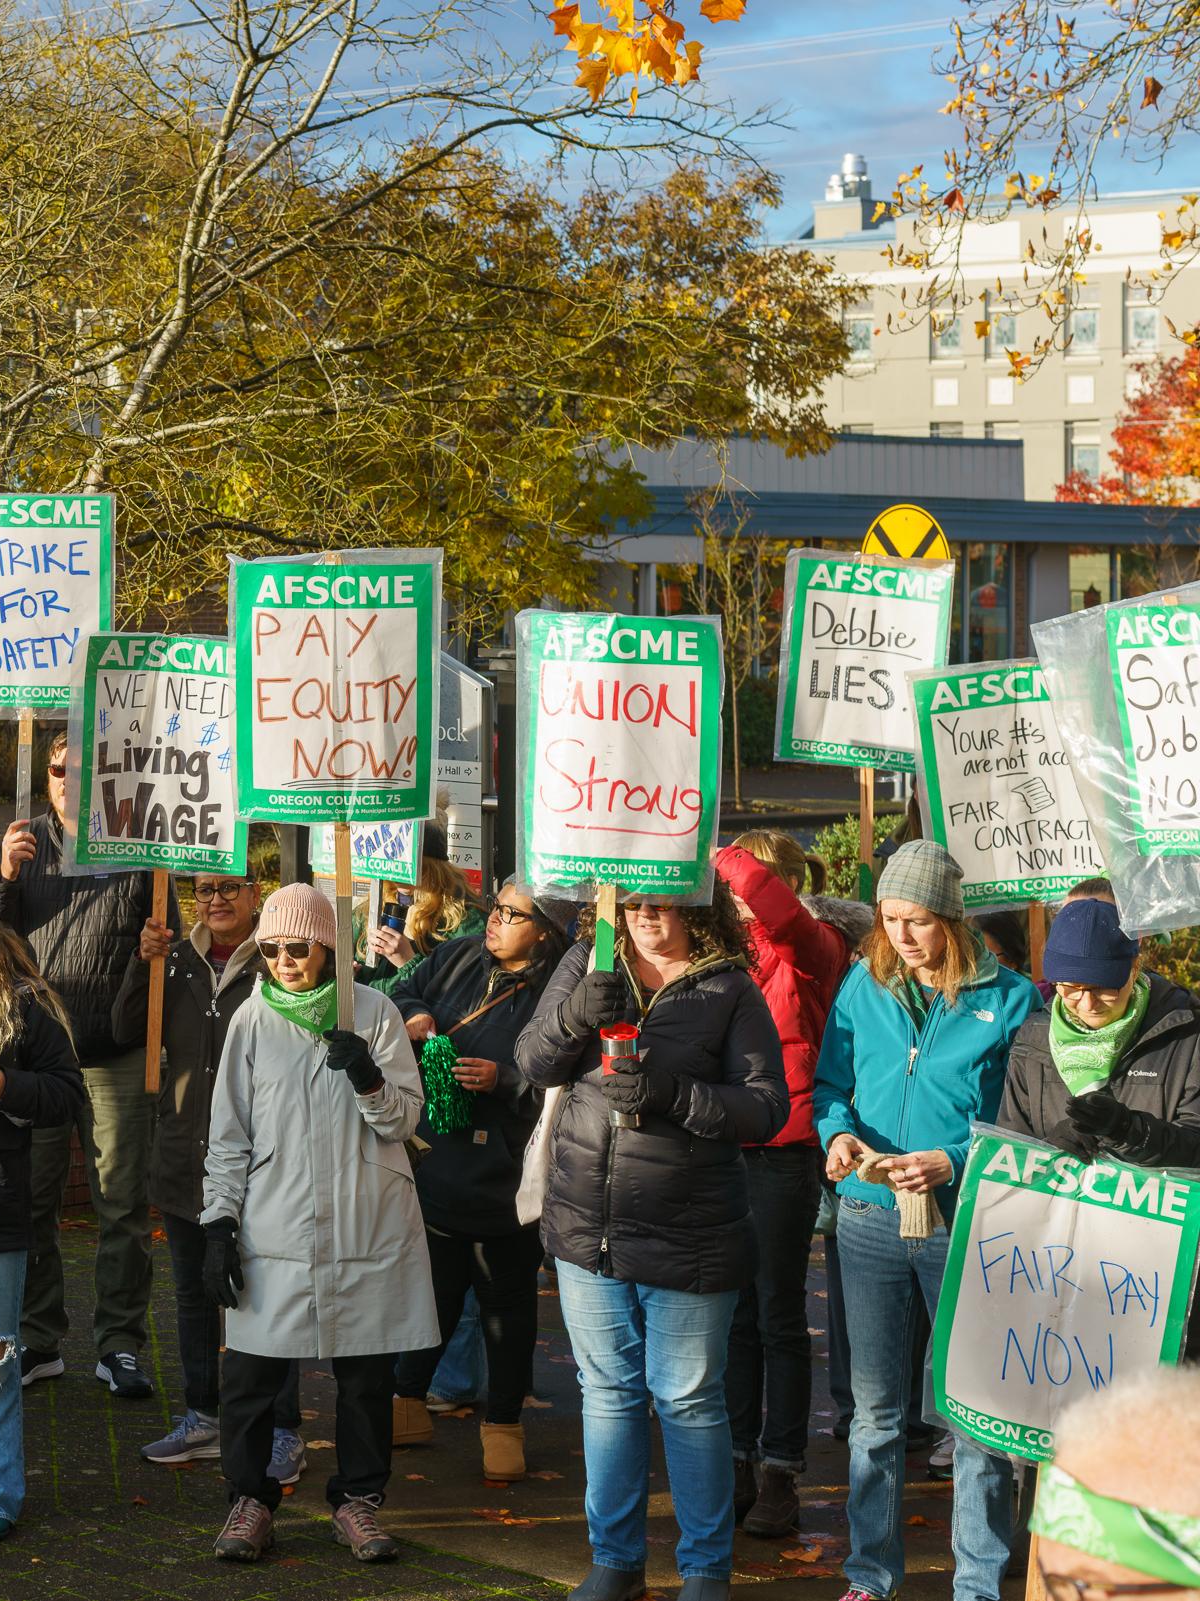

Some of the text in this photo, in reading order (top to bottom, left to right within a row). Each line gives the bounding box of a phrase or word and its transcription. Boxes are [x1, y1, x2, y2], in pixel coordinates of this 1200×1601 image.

[256, 576, 414, 604] AFSCME
[808, 564, 945, 600] AFSCME
[0, 588, 70, 623] FOR
[256, 613, 378, 657] PAY
[812, 601, 916, 648] Debbie
[543, 627, 698, 661] AFSCME
[104, 674, 236, 719] WE NEED
[257, 675, 416, 723] EQUITY
[541, 664, 696, 737] UNION
[809, 659, 908, 712] LIES.
[129, 720, 141, 735] a
[937, 717, 1003, 755] YOUR
[1136, 714, 1197, 762] Job
[98, 736, 211, 803] Living
[445, 766, 461, 775] Hall
[791, 741, 847, 756] OREGON
[850, 747, 907, 764] COUNCIL
[963, 757, 996, 777] are
[996, 749, 1028, 773] not
[102, 779, 221, 846] WAGE
[269, 795, 400, 806] OREGON COUNCIL 75
[949, 800, 1004, 827] FAIR
[88, 843, 147, 857] OREGON
[151, 846, 212, 862] COUNCIL
[217, 853, 234, 864] 75
[975, 820, 1092, 851] CONTRACT
[1146, 830, 1199, 842] OREGON
[599, 863, 660, 876] COUNCIL
[665, 866, 680, 877] 75
[1017, 848, 1063, 873] NOW
[982, 1143, 1190, 1221] AFSCME
[979, 1232, 1159, 1327] FAIR PAY
[1002, 1322, 1113, 1392] NOW
[946, 1398, 1020, 1440] OREGON
